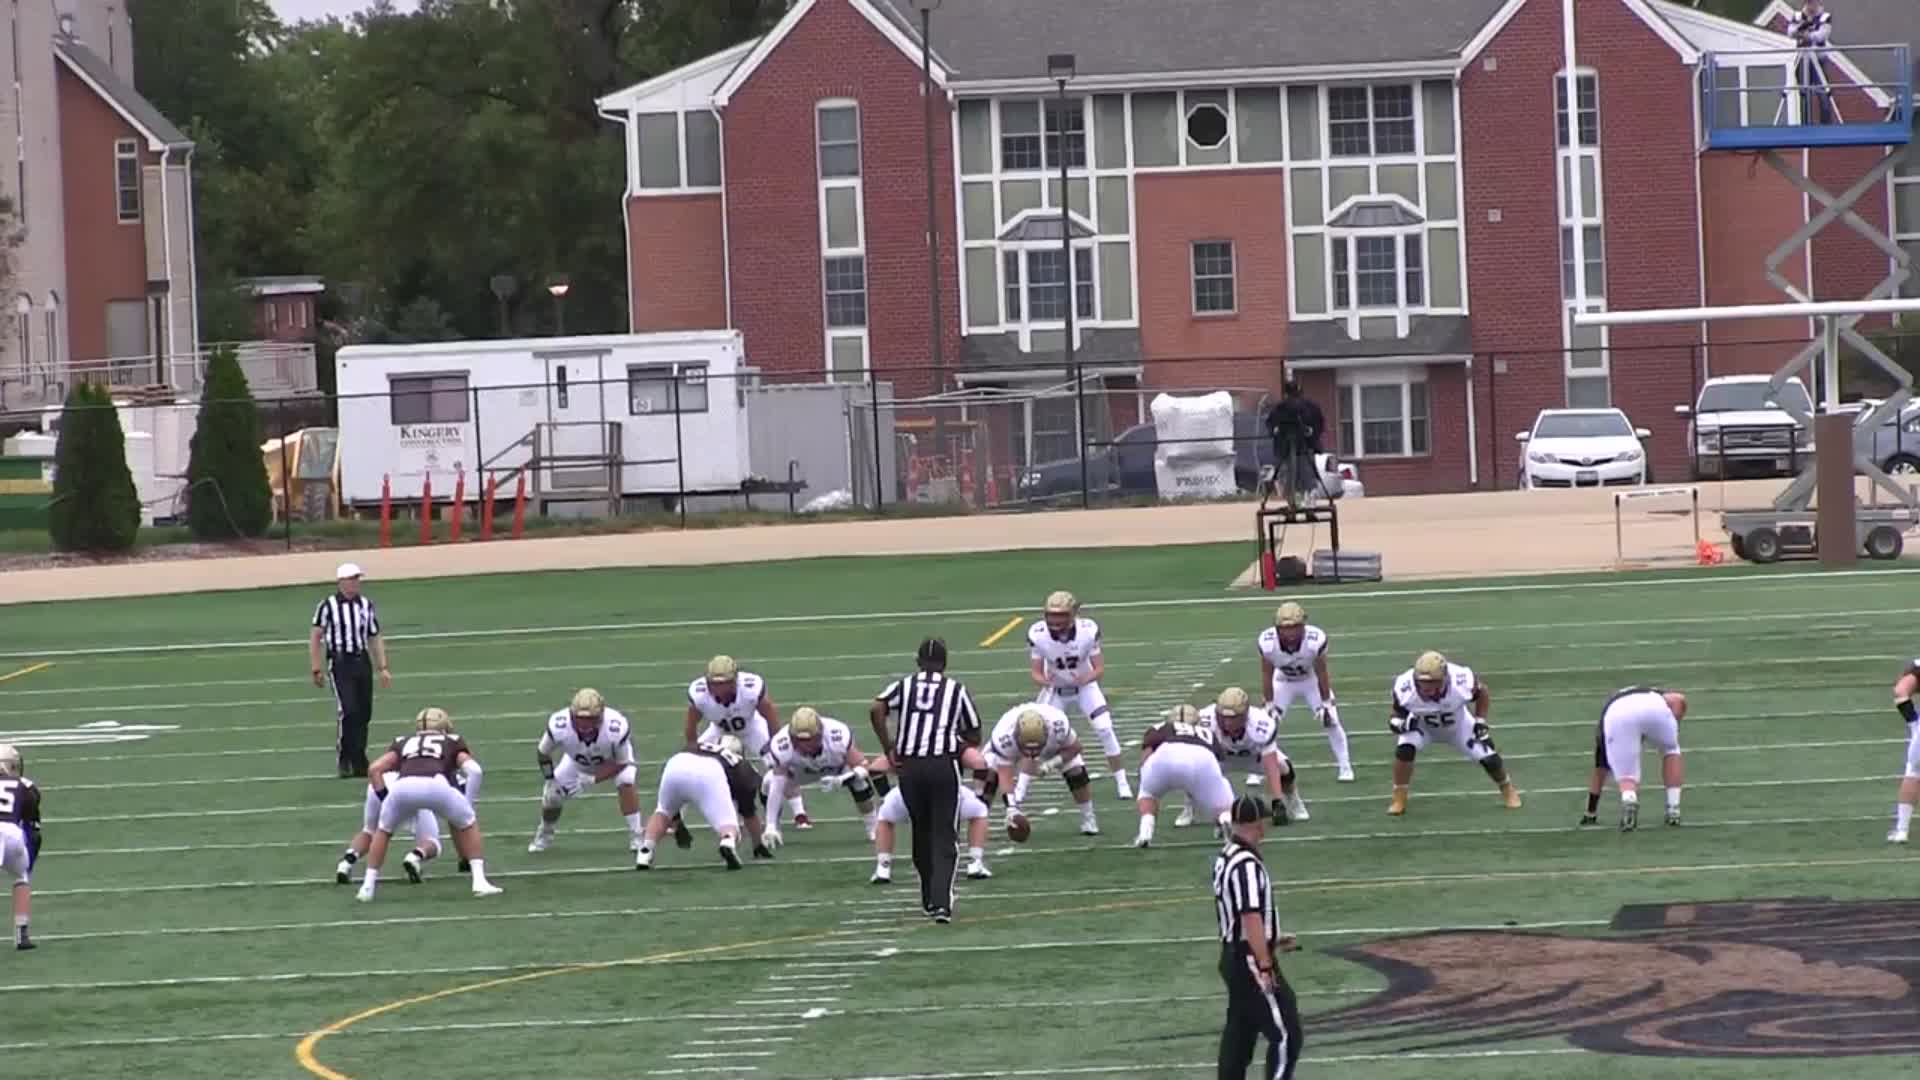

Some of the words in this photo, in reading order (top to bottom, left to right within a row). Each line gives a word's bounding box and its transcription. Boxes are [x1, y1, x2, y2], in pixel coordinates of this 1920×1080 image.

[400, 427, 460, 439] KINGERY
[1056, 656, 1079, 670] 17
[916, 682, 939, 710] U
[718, 716, 745, 732] 40
[402, 734, 445, 759] 45
